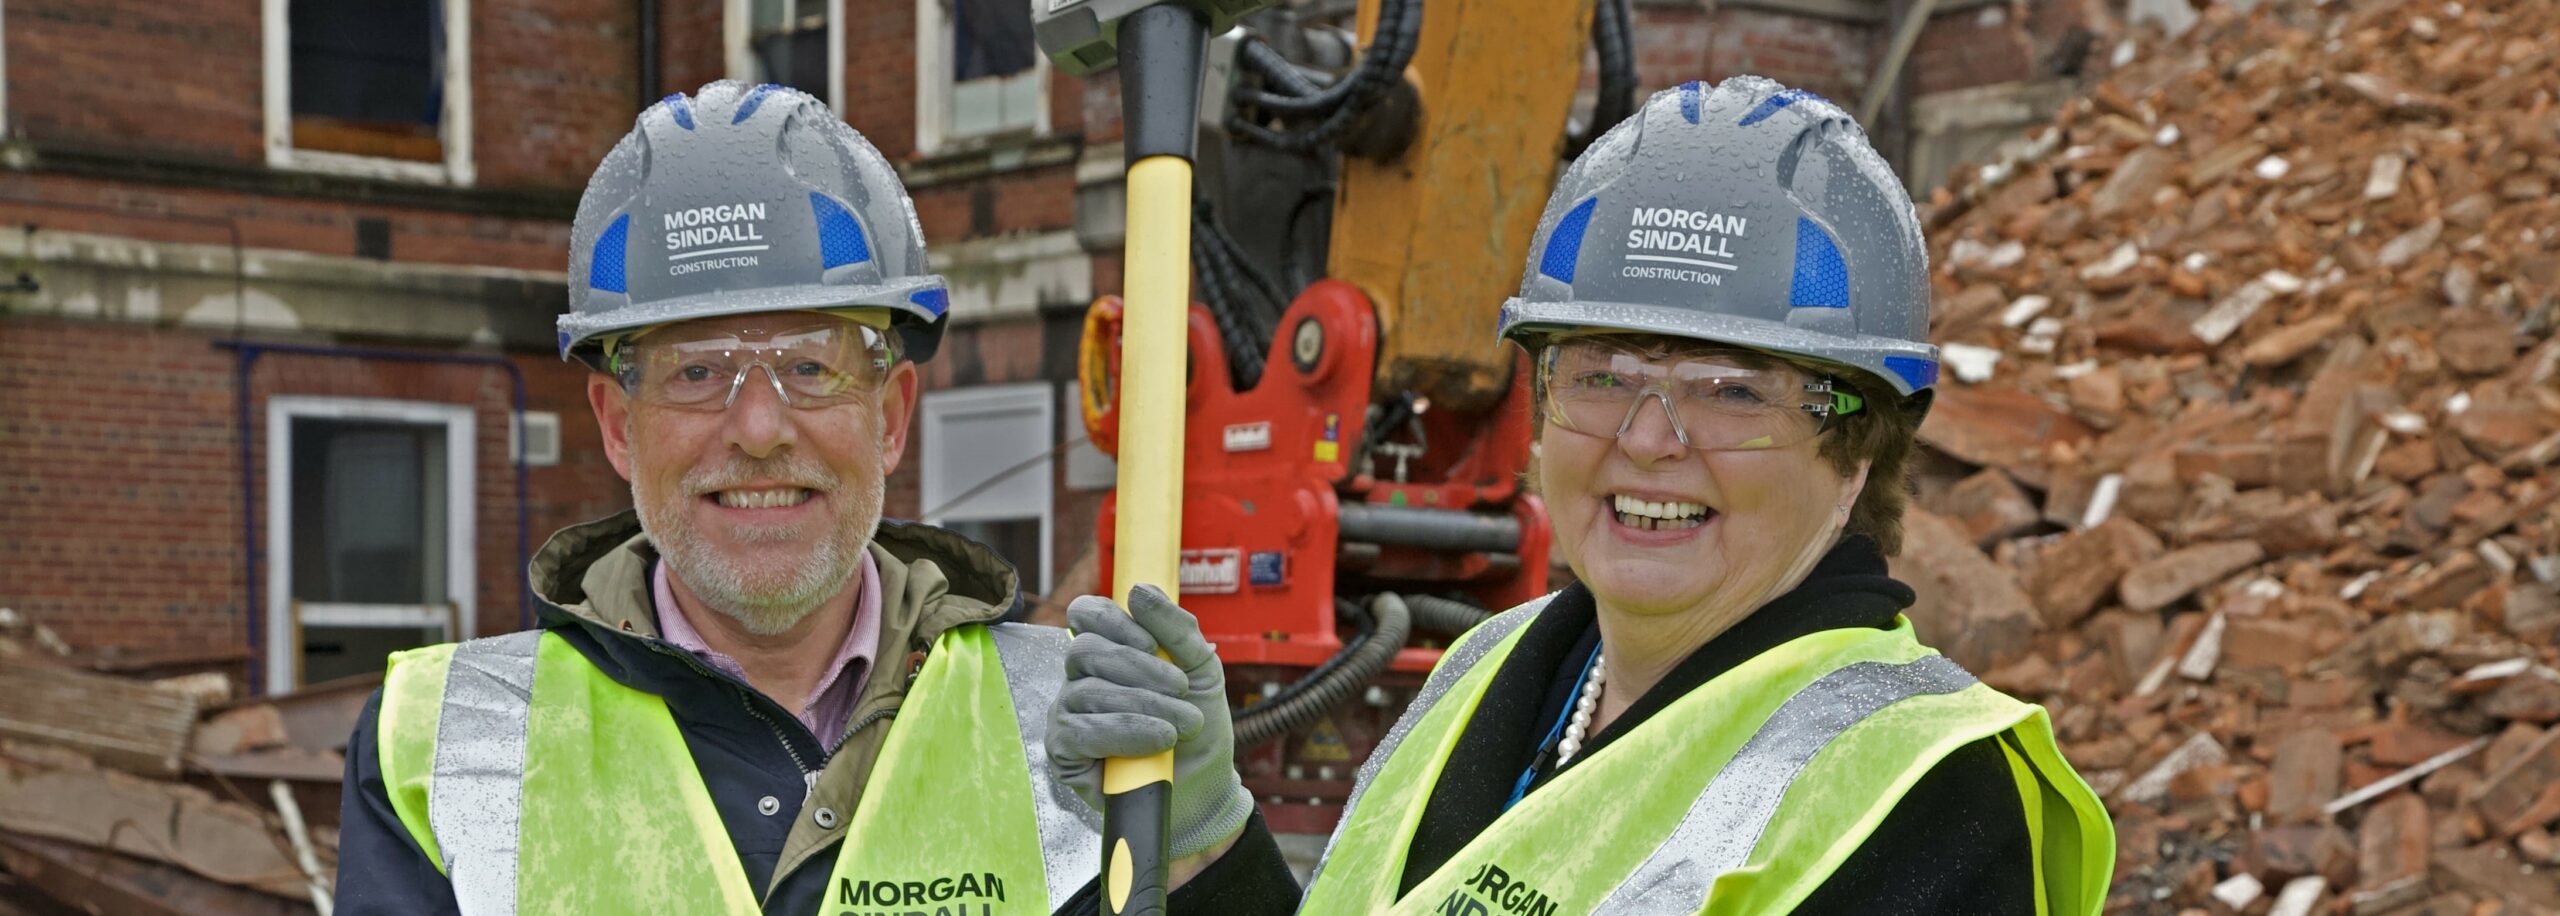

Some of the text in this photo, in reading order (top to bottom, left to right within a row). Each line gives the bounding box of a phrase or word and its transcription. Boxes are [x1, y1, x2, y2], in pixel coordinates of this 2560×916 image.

[664, 203, 766, 230] MORGAN
[1632, 207, 1747, 236] MORGAN
[666, 223, 763, 250] SINDALL
[1627, 229, 1734, 258] SINDALL
[670, 256, 758, 276] CONSTRUCTION
[1622, 266, 1721, 286] CONSTRUCTION
[839, 872, 1005, 907] MORGAN
